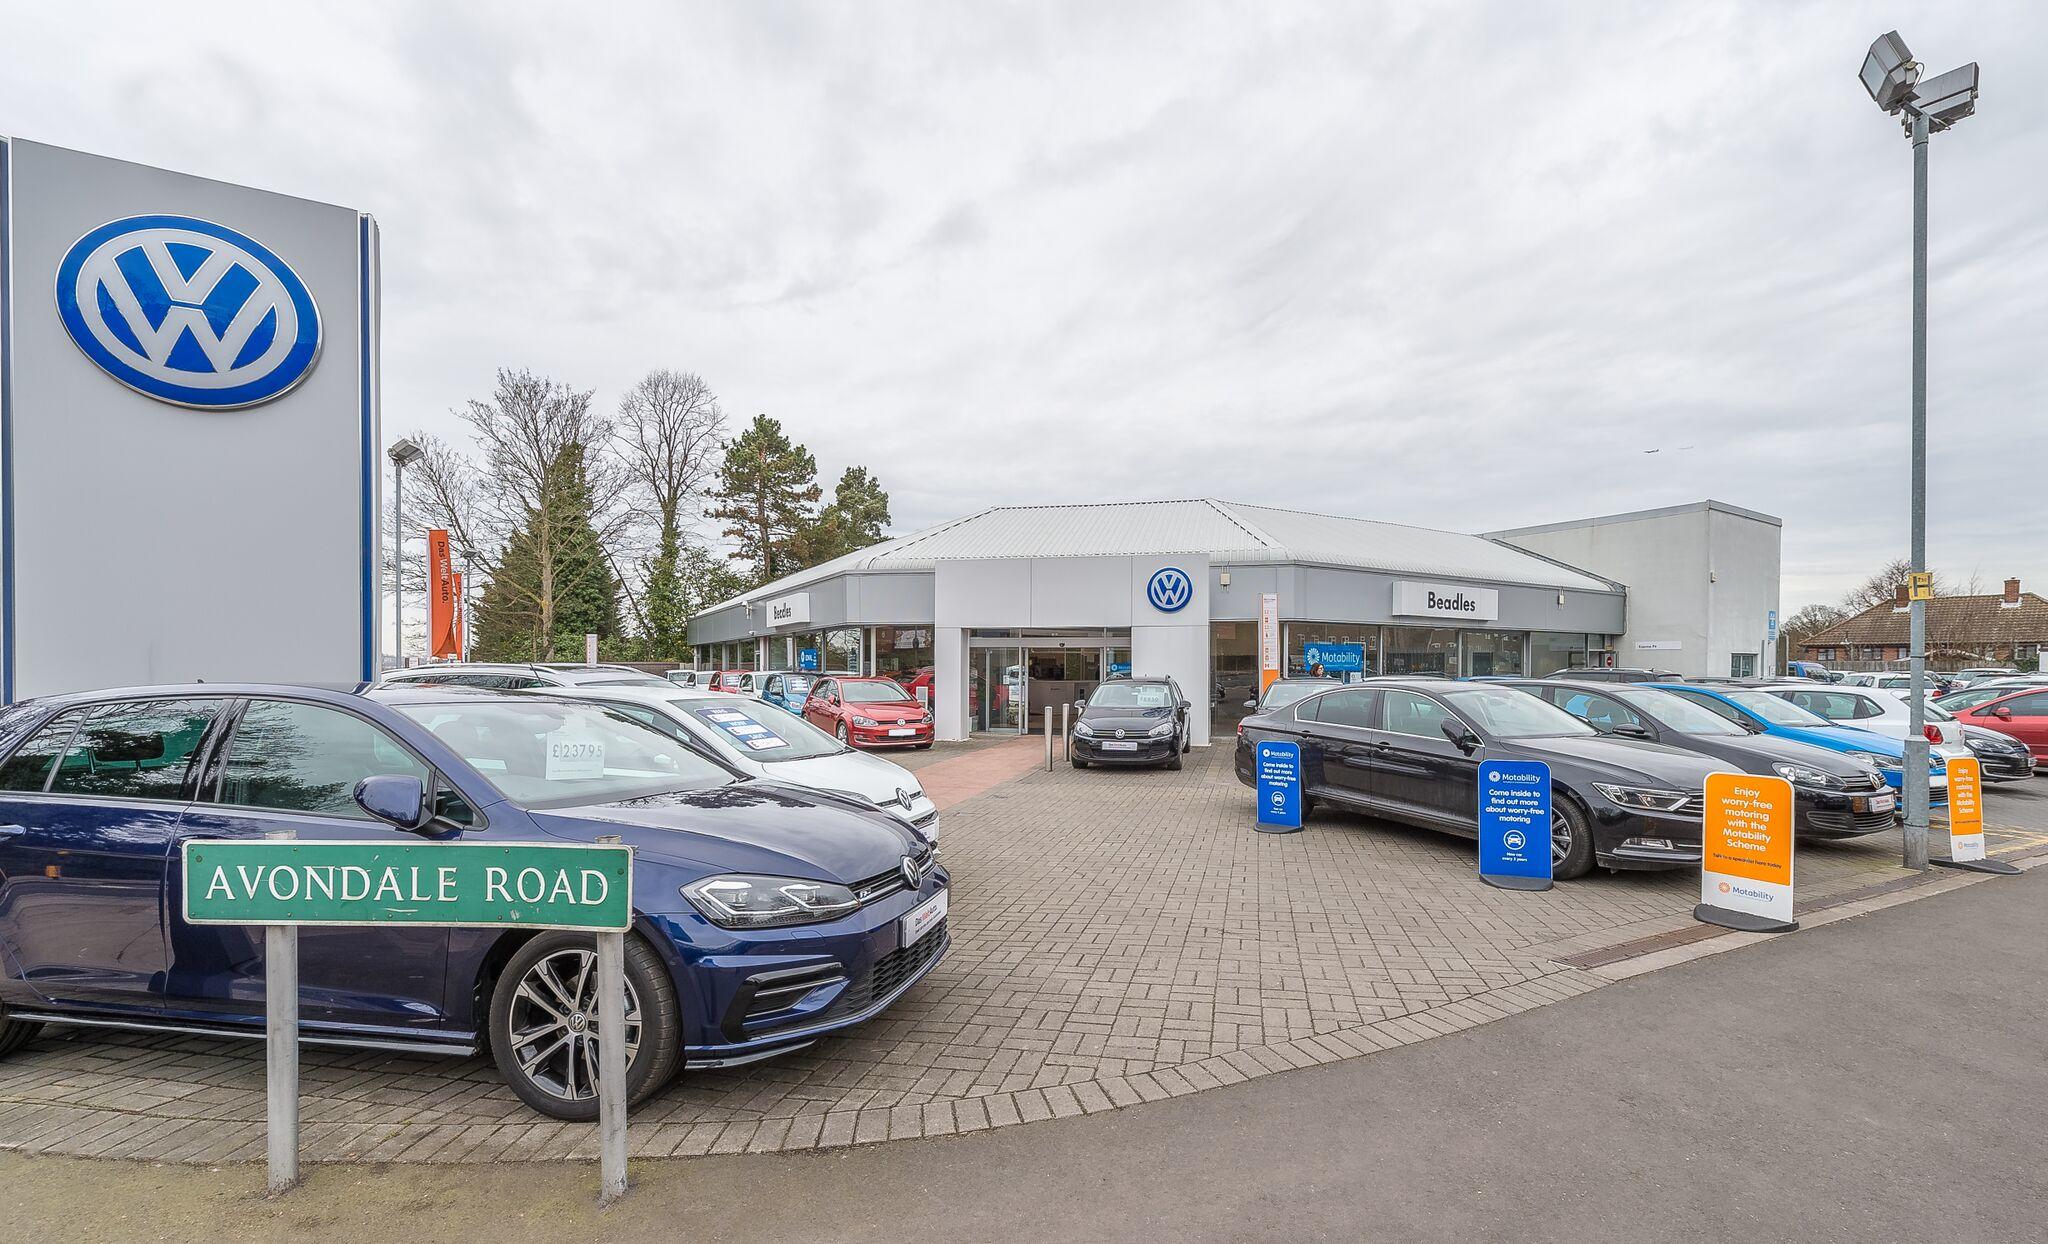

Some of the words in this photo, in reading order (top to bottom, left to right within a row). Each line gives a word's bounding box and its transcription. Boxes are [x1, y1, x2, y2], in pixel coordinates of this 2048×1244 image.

[72, 224, 304, 393] VW
[437, 541, 446, 557] Das
[1150, 570, 1188, 609] VW
[1427, 591, 1476, 612] Beadles
[773, 602, 792, 620] Beadles
[1321, 651, 1361, 666] Motability
[1271, 751, 1294, 759] Motability
[1502, 773, 1541, 783] Motability
[1488, 788, 1510, 797] Come
[1510, 789, 1532, 797] inside
[1532, 790, 1541, 798] to
[1734, 787, 1760, 798] Enjoy
[1490, 797, 1505, 805] find
[1506, 798, 1519, 806] out
[1721, 797, 1773, 810] worry-free
[1485, 805, 1507, 813] about
[1507, 807, 1545, 816] worry-free
[1725, 808, 1770, 822] motoring
[1499, 815, 1531, 824] motoring
[1727, 819, 1748, 829] with
[1750, 821, 1767, 831] the
[1722, 828, 1771, 843] Motability
[1726, 838, 1767, 852] Scheme
[205, 865, 460, 902] AVONDALE
[485, 867, 609, 905] ROAD
[1732, 886, 1774, 902] Motability
